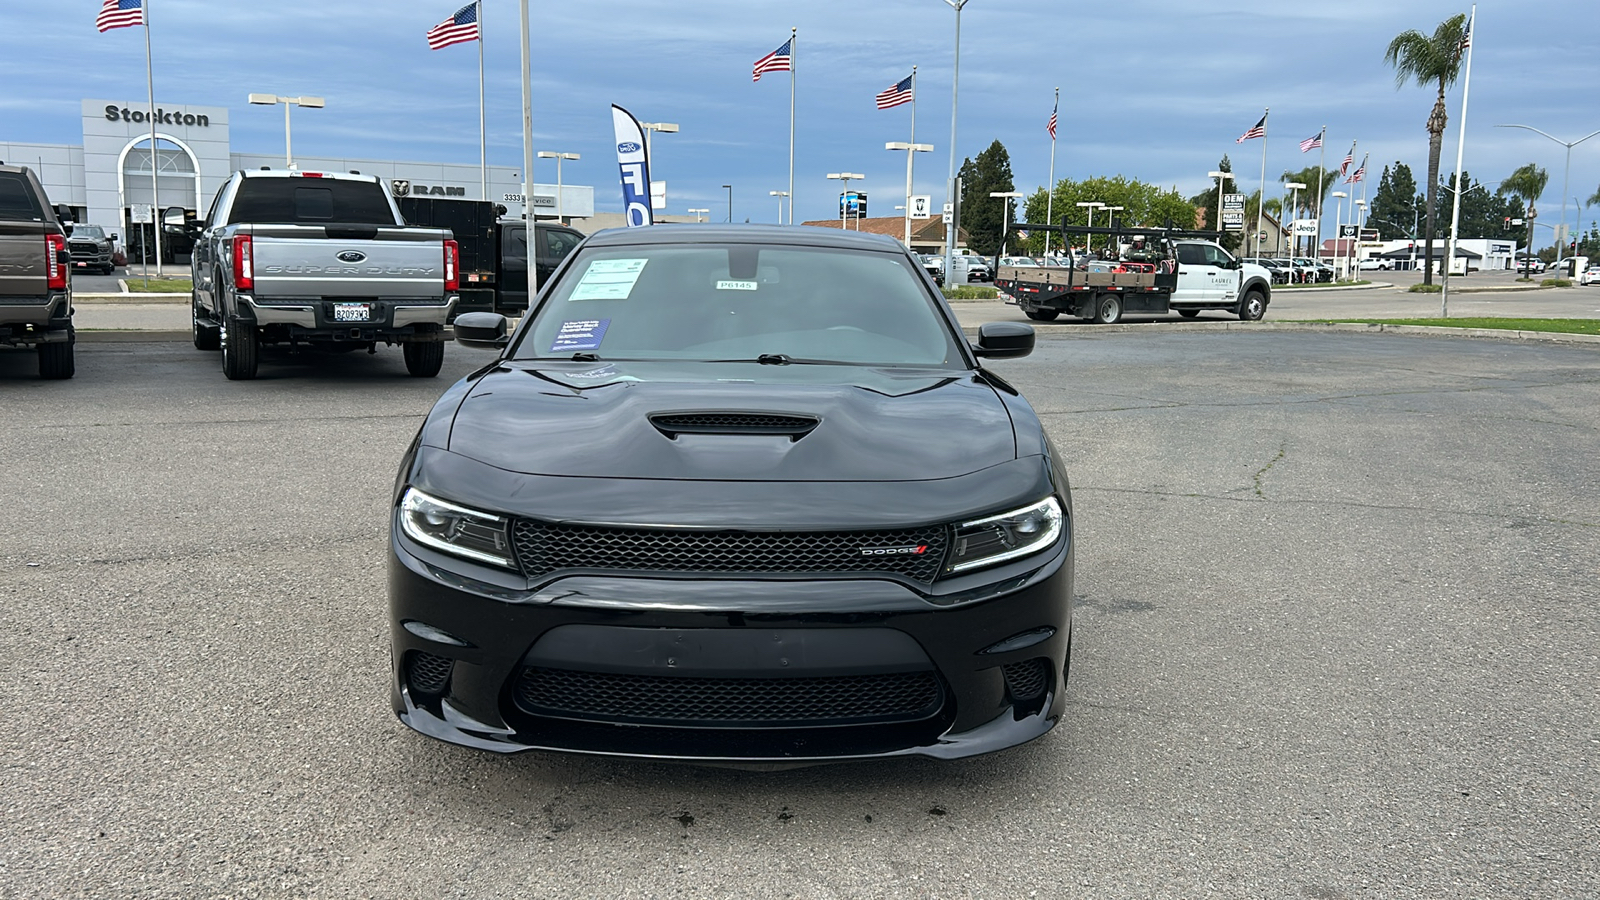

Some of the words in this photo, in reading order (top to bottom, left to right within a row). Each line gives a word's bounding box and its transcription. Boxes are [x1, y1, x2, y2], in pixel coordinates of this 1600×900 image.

[105, 105, 209, 127] Stockton
[413, 185, 465, 196] RAM
[504, 193, 521, 202] 3333
[1224, 195, 1244, 203] OEM
[1296, 225, 1316, 233] Jeep
[266, 265, 359, 274] SUPER
[367, 266, 434, 275] DUTY
